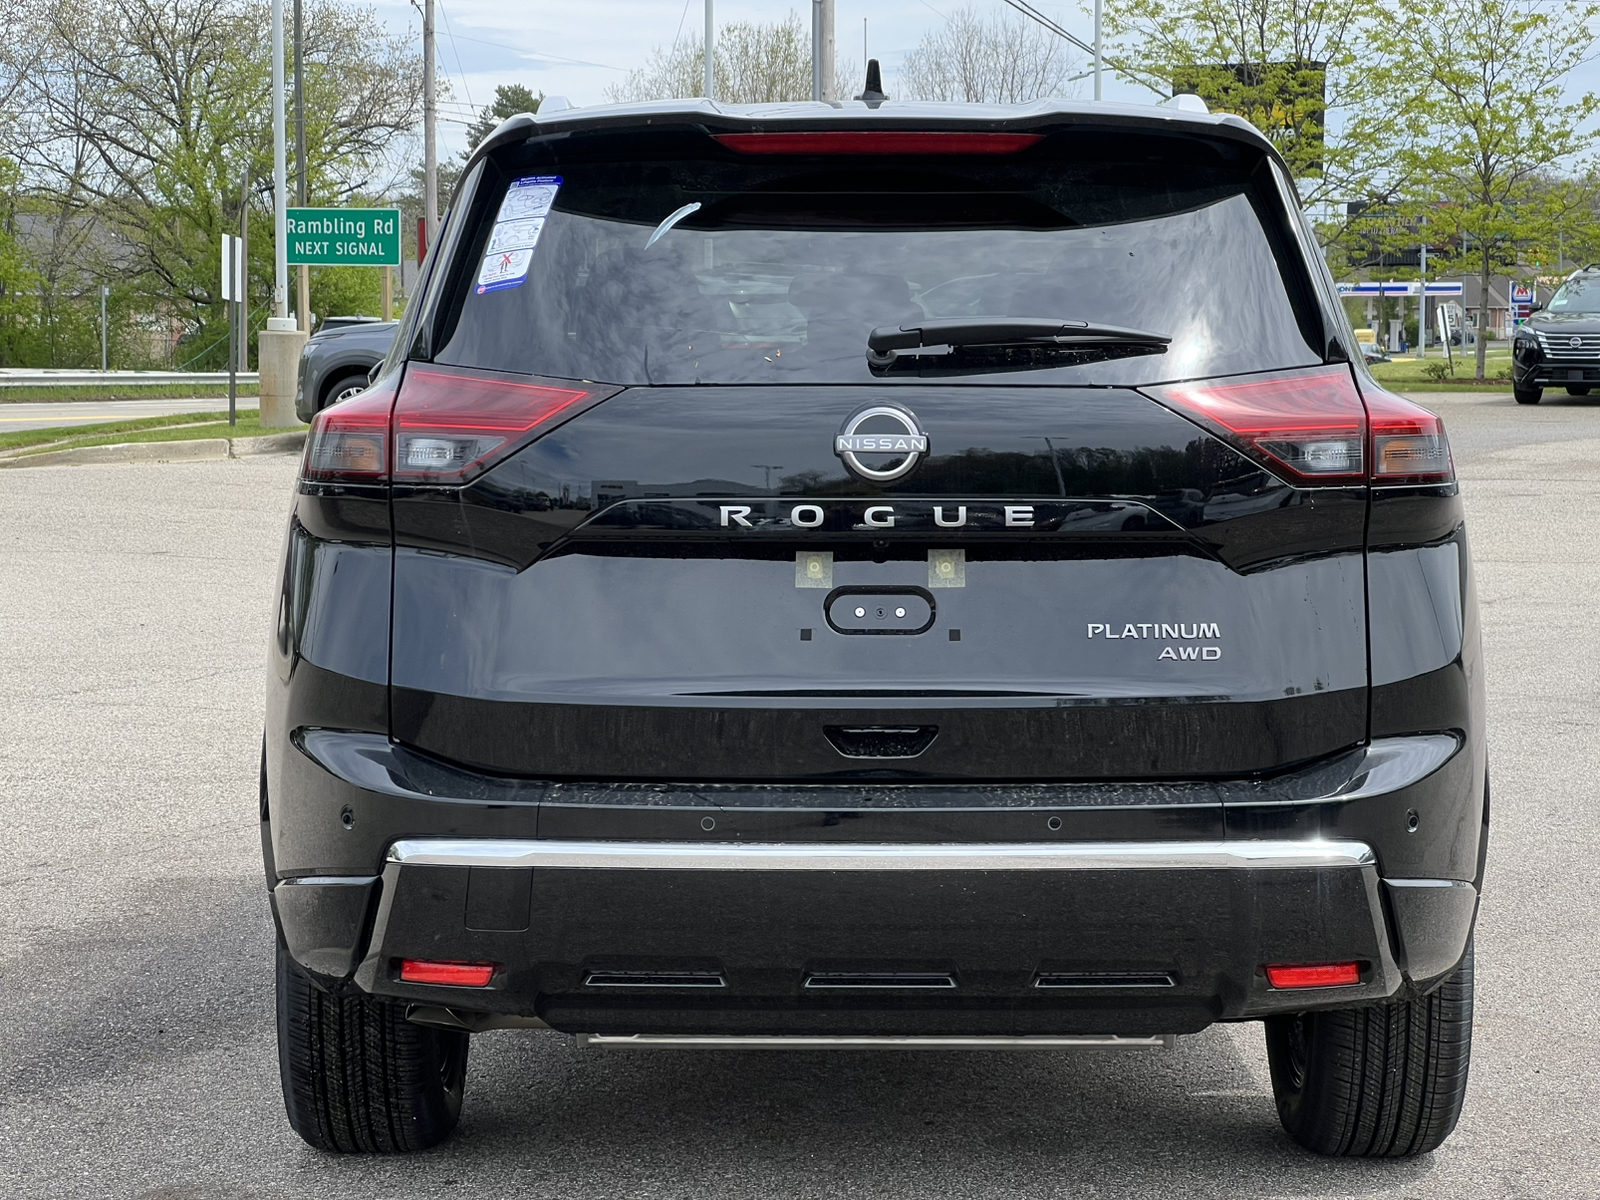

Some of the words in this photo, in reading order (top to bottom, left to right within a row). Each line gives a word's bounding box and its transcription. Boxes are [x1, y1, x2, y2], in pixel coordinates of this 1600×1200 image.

[287, 217, 365, 239] Rambling
[373, 218, 394, 235] Rd
[295, 241, 329, 255] NEXT
[335, 242, 385, 256] SIGNAL
[839, 438, 924, 450] NISSAN
[719, 505, 1035, 528] ROGUE
[1087, 622, 1221, 639] PLATINUM
[1158, 646, 1222, 660] AWD
